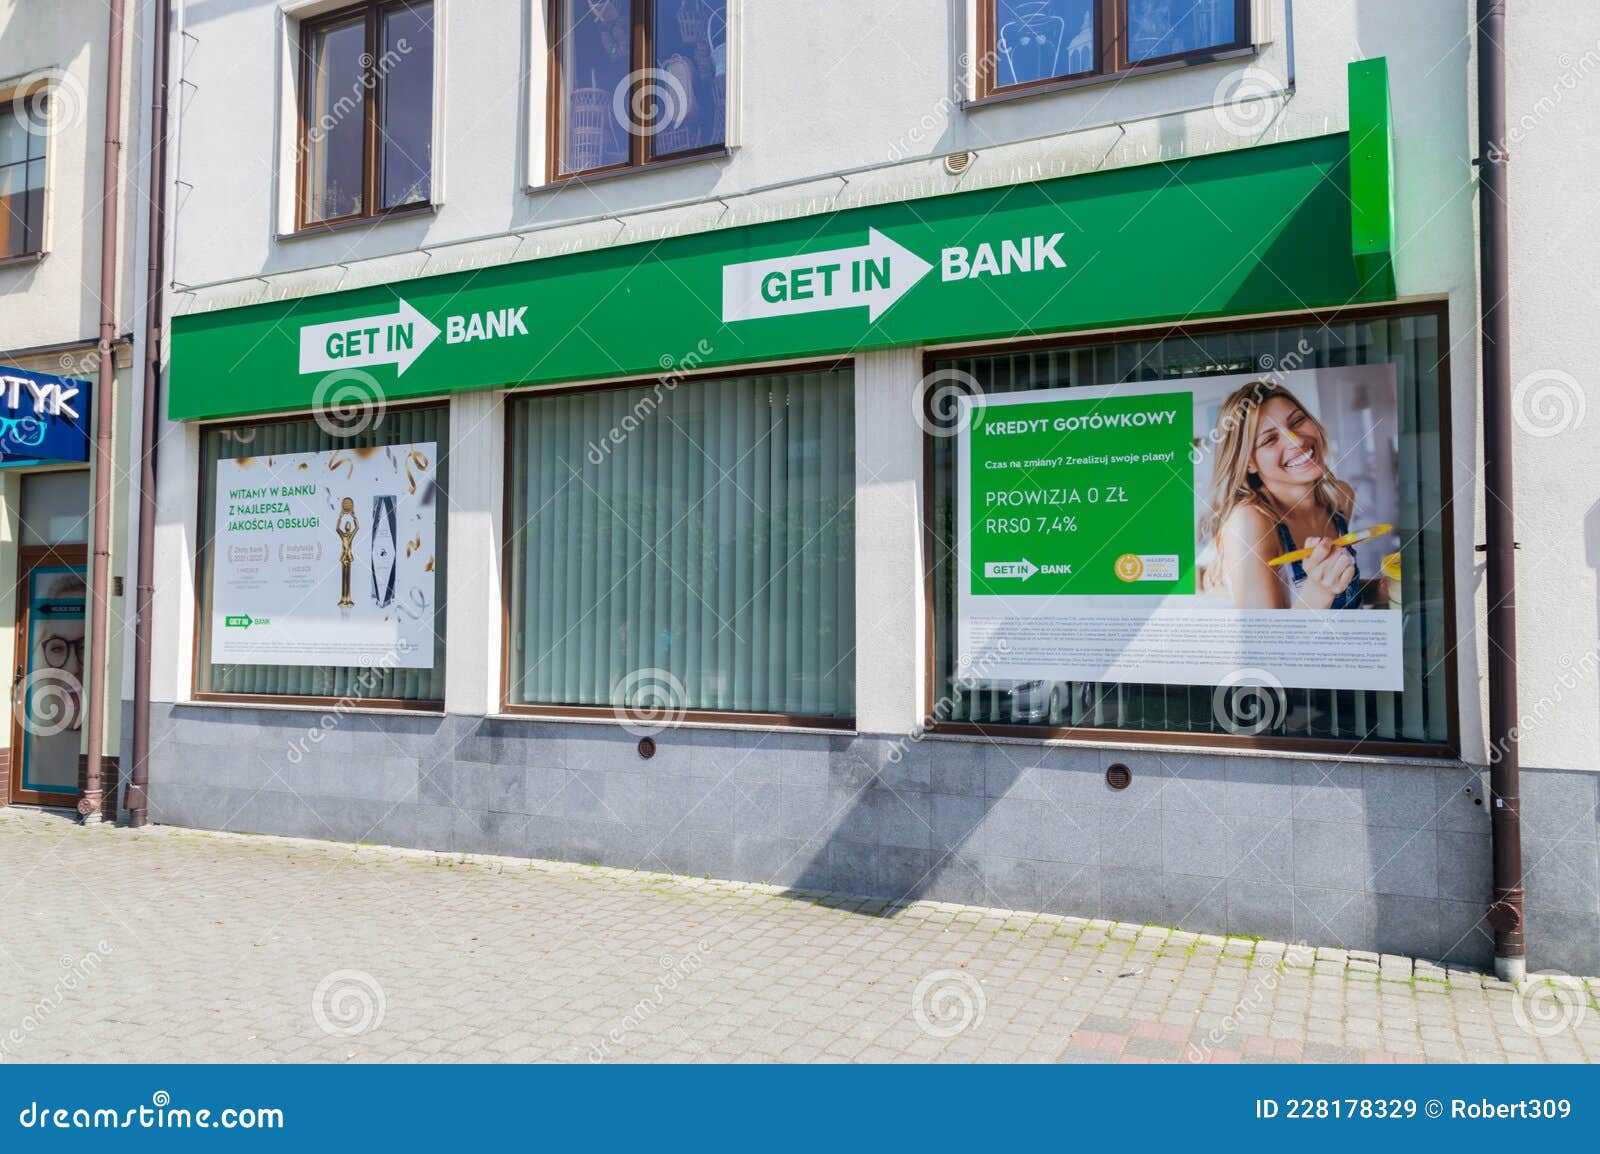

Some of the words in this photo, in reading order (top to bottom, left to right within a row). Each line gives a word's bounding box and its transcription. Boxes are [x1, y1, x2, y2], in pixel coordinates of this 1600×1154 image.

[760, 264, 840, 303] GET
[851, 256, 891, 293] IN
[941, 232, 1067, 282] BANK
[325, 327, 380, 359] GET
[387, 322, 414, 352] IN
[446, 306, 529, 344] BANK
[0, 375, 80, 419] TYK
[984, 418, 1049, 436] KREDYT
[1053, 410, 1177, 432] GOTÓWKOWY
[984, 460, 1008, 470] Czas
[1009, 460, 1021, 468] na
[1023, 457, 1063, 469] zmiany?
[1065, 454, 1109, 467] Zrealizuj
[1110, 453, 1140, 464] swoje
[1142, 451, 1175, 463] plany!
[229, 488, 267, 500] WITAMY
[269, 487, 279, 496] W
[281, 484, 317, 497] BANKU
[986, 488, 1081, 507] PROWIZJA
[1105, 486, 1129, 503] ZŁ
[229, 505, 235, 516] Z
[237, 501, 292, 516] NAJLEPSZĄ
[228, 517, 274, 532] JAKOŚCIĄ
[277, 516, 320, 529] OBSŁUGI
[1036, 516, 1077, 535] 7,4%
[993, 566, 1014, 574] GET
[1017, 566, 1029, 574] IN
[1040, 564, 1072, 574] BANK
[255, 617, 270, 625] BANK
